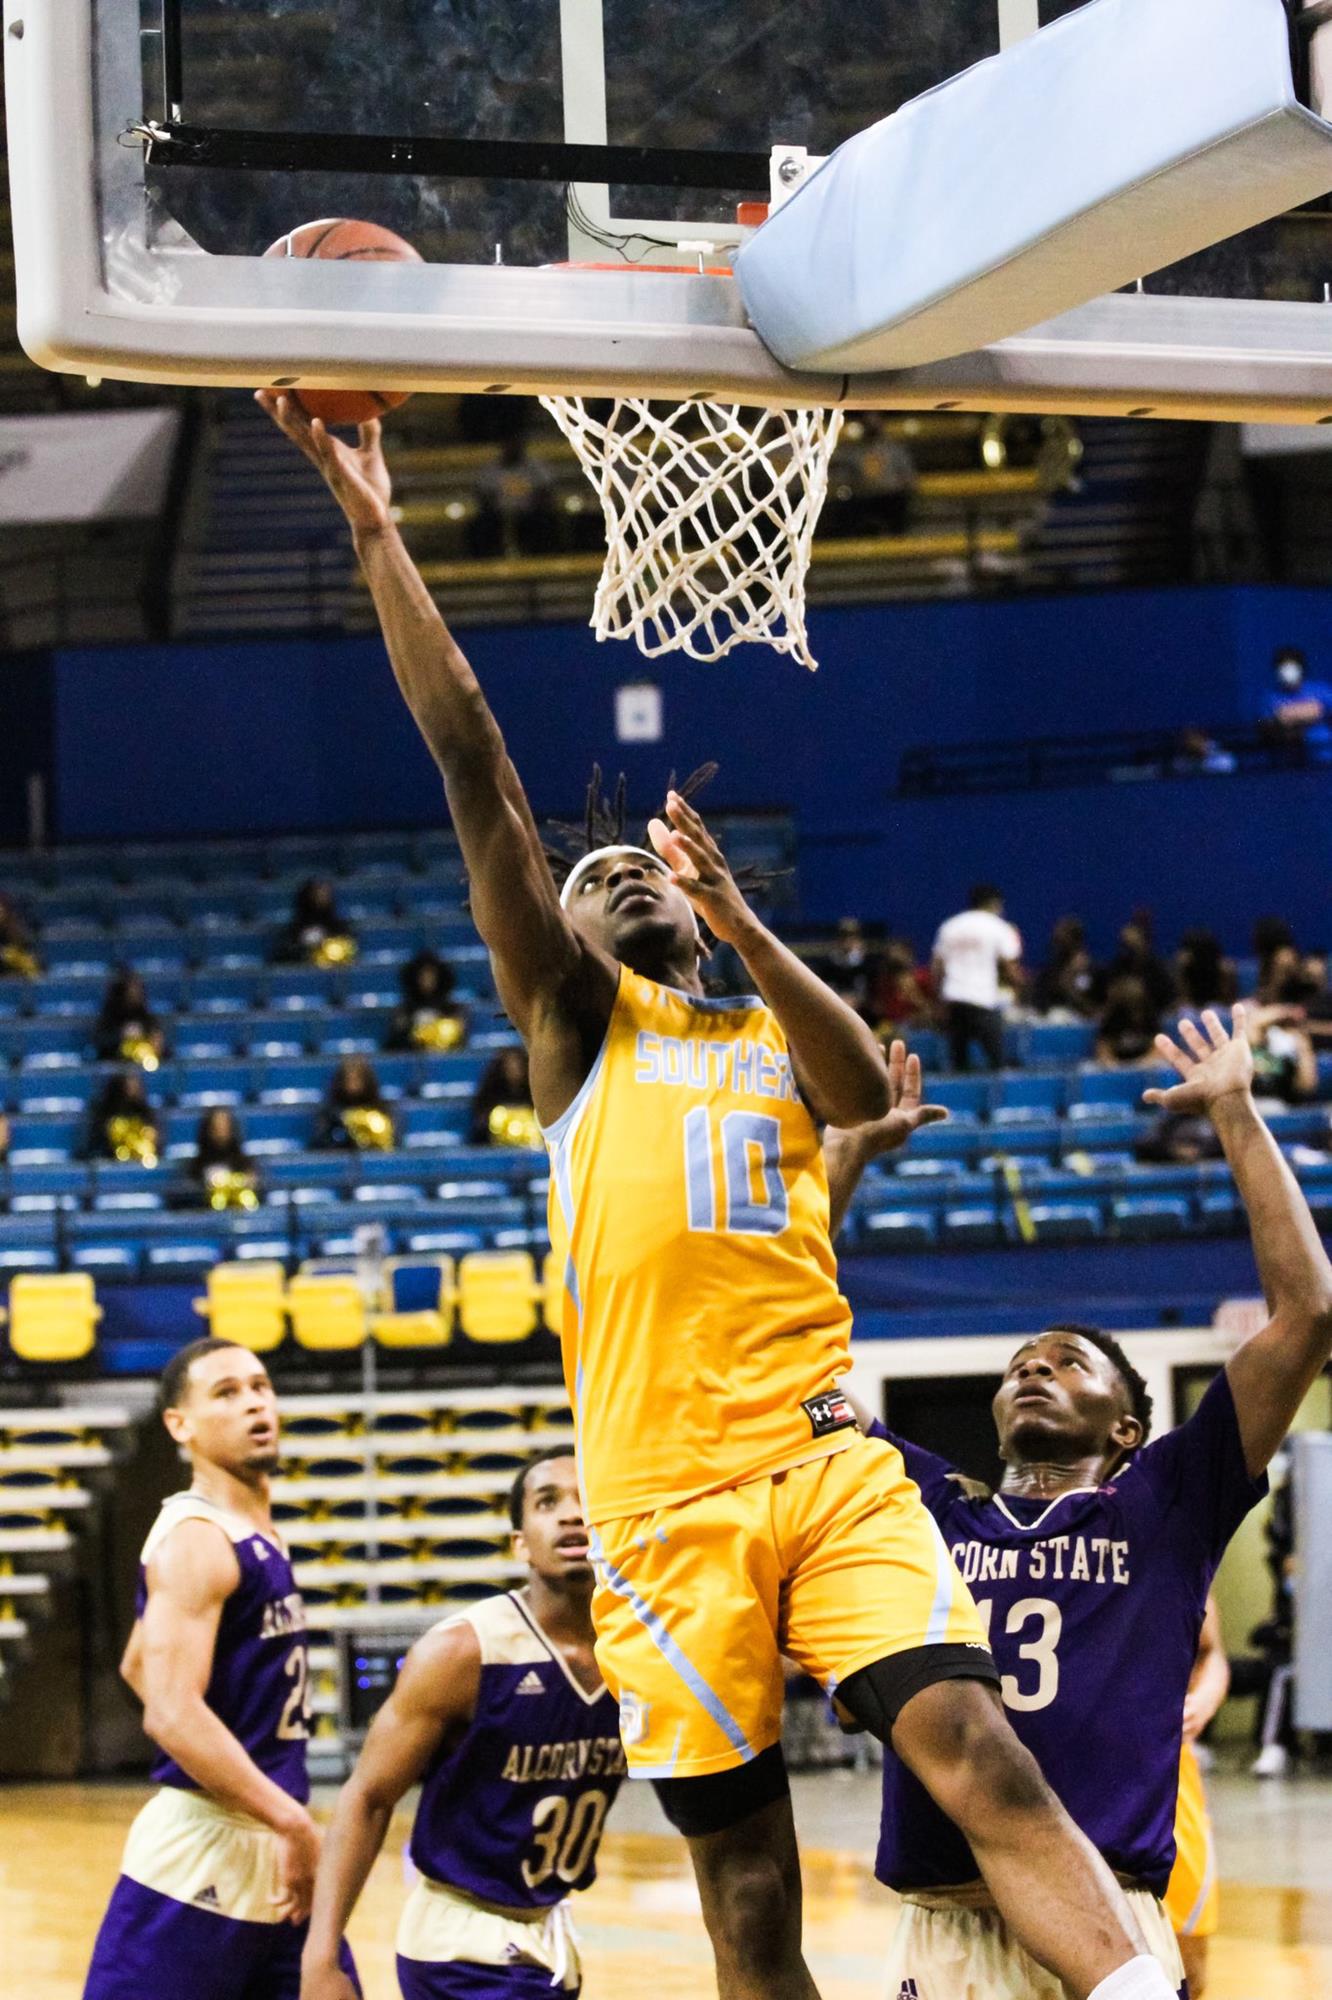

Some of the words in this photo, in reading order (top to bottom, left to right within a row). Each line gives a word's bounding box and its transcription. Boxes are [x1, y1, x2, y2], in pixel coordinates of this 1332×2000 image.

[683, 1105, 790, 1237] 10
[1029, 1536, 1130, 1585] STATE
[976, 1597, 1063, 1712] 3
[521, 1790, 607, 1888] 30
